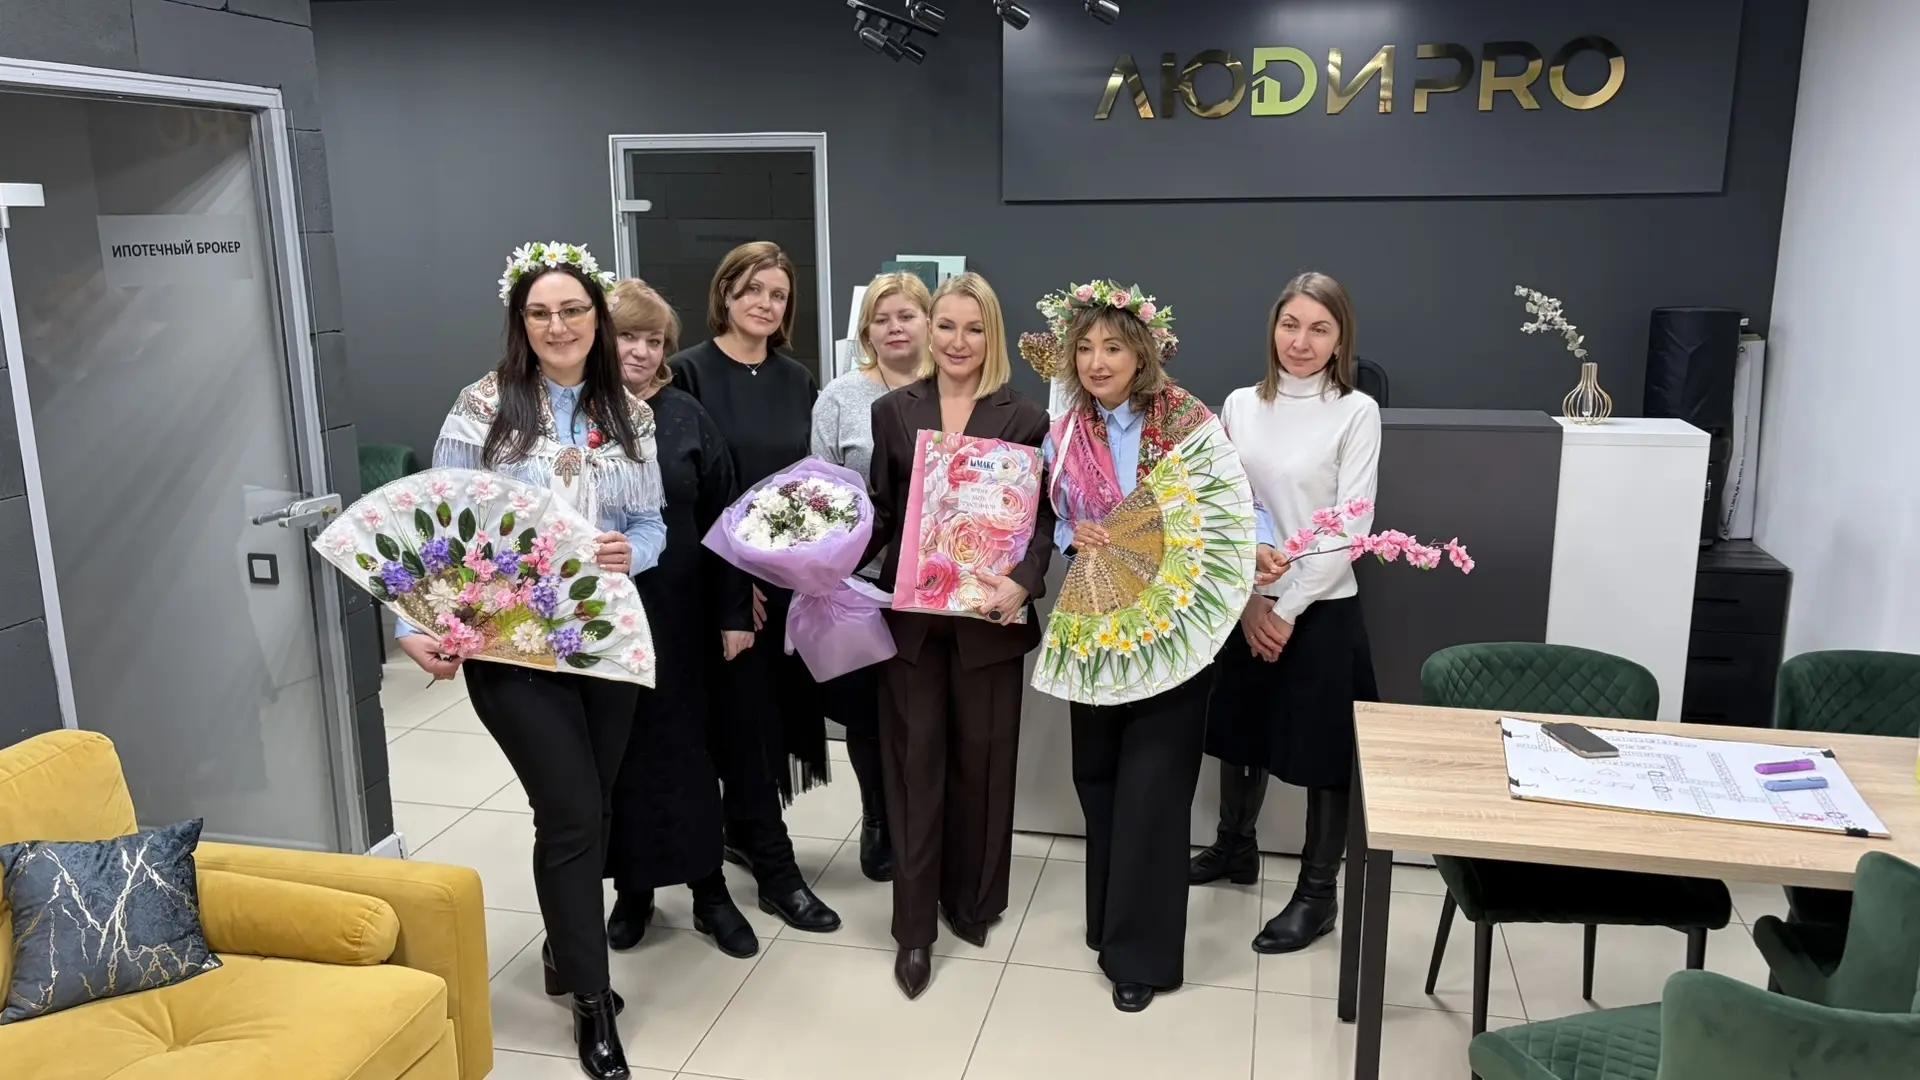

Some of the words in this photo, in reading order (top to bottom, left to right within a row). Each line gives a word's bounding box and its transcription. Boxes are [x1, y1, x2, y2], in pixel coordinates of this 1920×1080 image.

[1413, 35, 1626, 113] PRO
[111, 239, 194, 258] ИПОТЕЧНЫЙ
[197, 241, 241, 255] БРОКЕР
